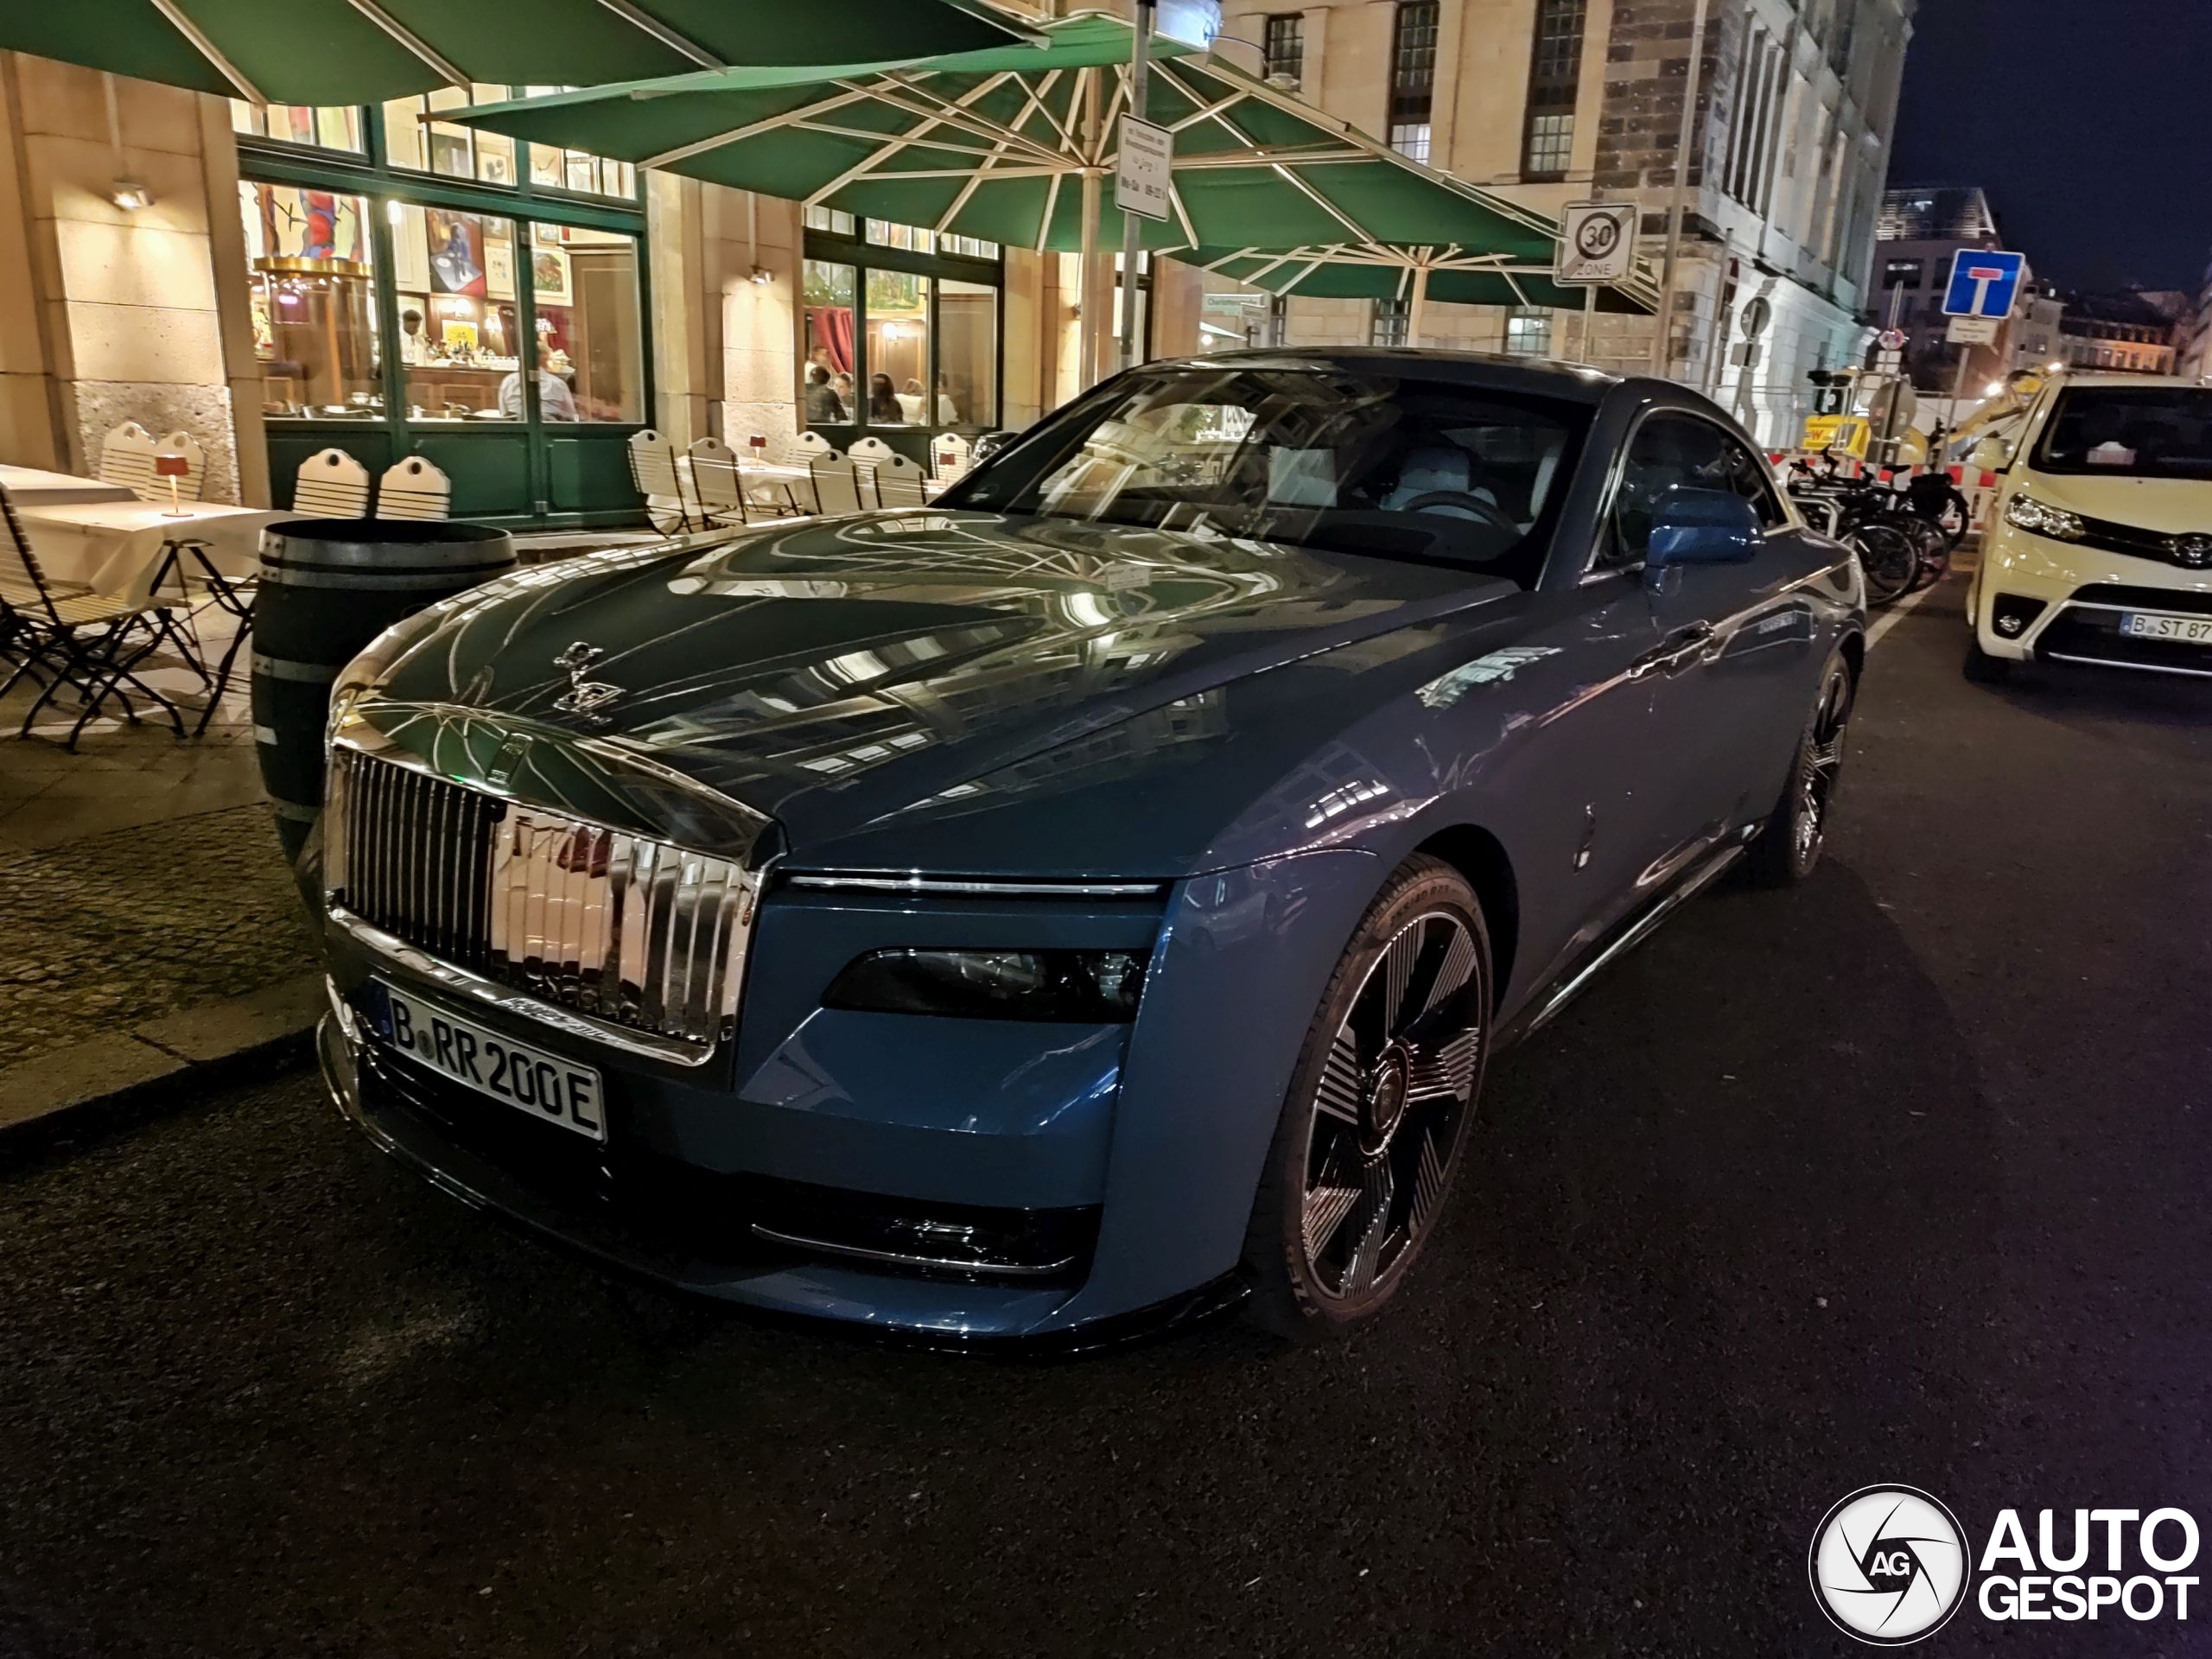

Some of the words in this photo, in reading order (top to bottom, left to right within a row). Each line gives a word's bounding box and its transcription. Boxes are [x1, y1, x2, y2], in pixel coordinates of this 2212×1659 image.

[1585, 225, 1612, 248] 30
[1577, 263, 1611, 276] ZONE
[2133, 617, 2146, 632] B
[2158, 620, 2183, 637] ST
[391, 996, 415, 1051] B
[431, 1016, 484, 1085] RR
[485, 1040, 599, 1132] 200E
